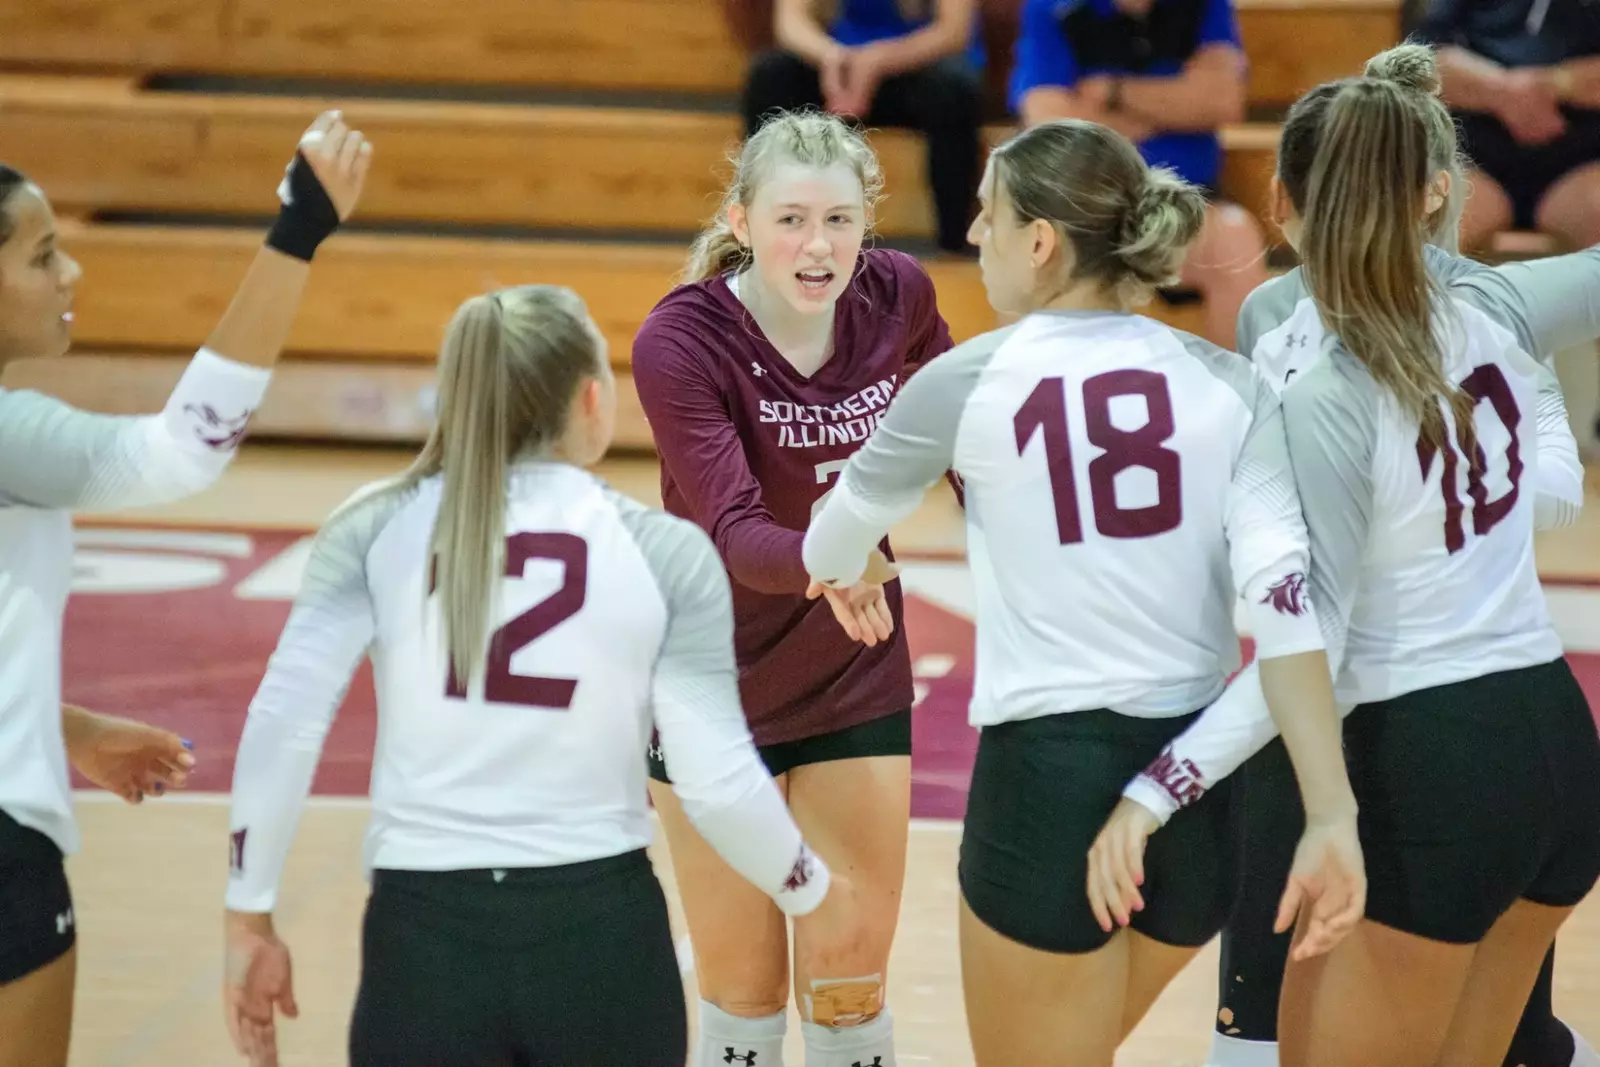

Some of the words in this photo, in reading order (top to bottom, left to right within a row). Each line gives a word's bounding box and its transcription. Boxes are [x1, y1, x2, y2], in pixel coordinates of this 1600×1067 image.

[759, 373, 897, 425] SOUTHERN
[1013, 368, 1183, 546] 18
[1415, 362, 1522, 556] 10
[427, 530, 589, 710] 2
